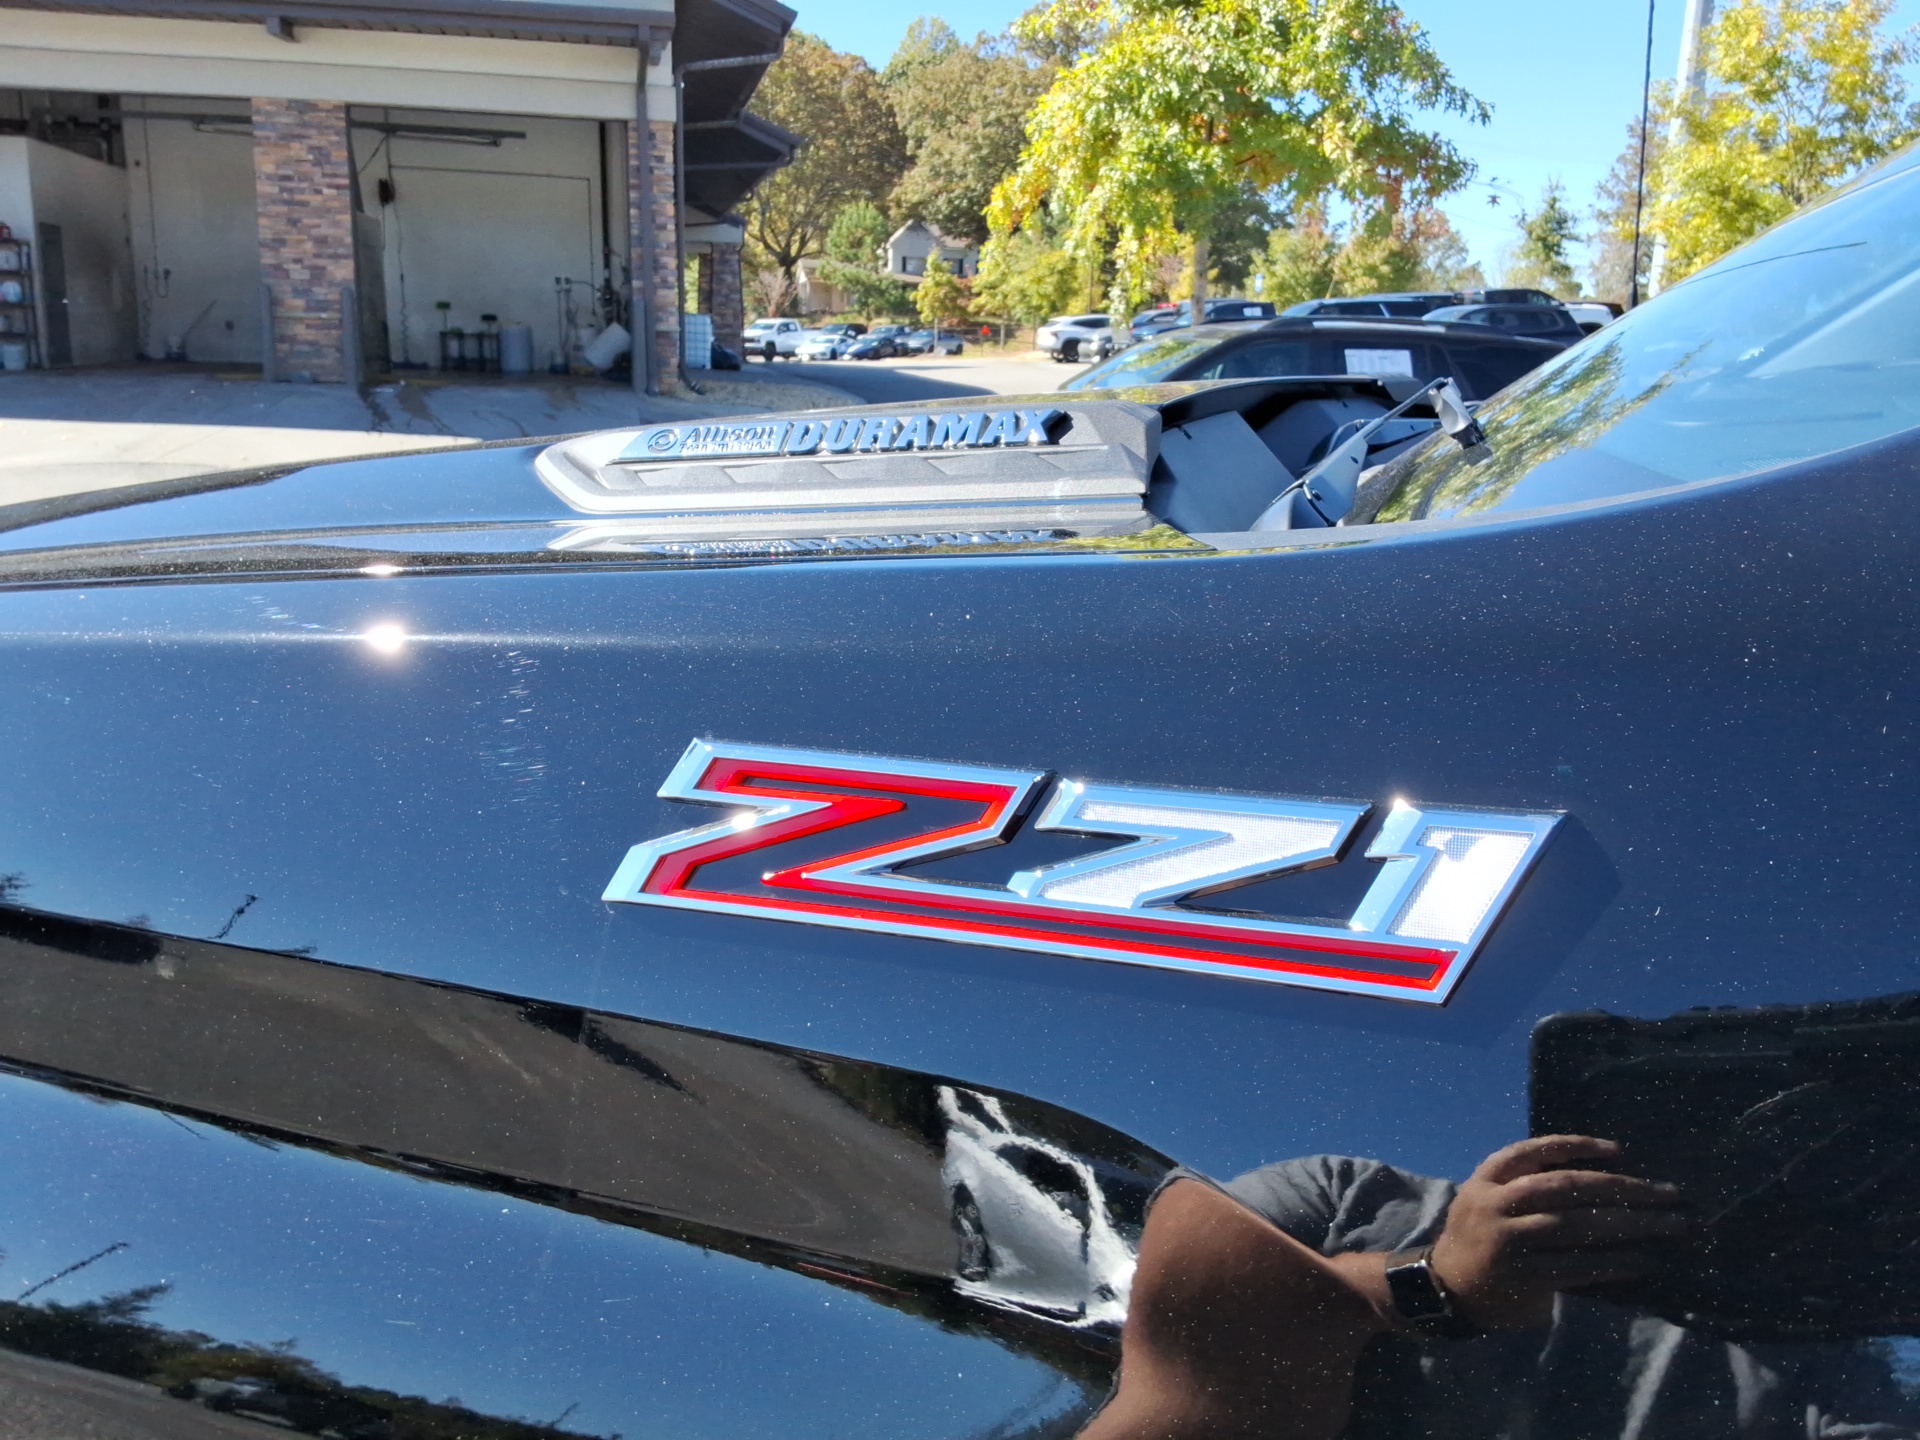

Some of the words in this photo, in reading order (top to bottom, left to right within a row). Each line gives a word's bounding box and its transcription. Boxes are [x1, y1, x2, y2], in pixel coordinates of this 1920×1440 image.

[683, 426, 777, 442] Allison
[787, 409, 1060, 453] DURAMAX
[602, 737, 1568, 1005] Z71
